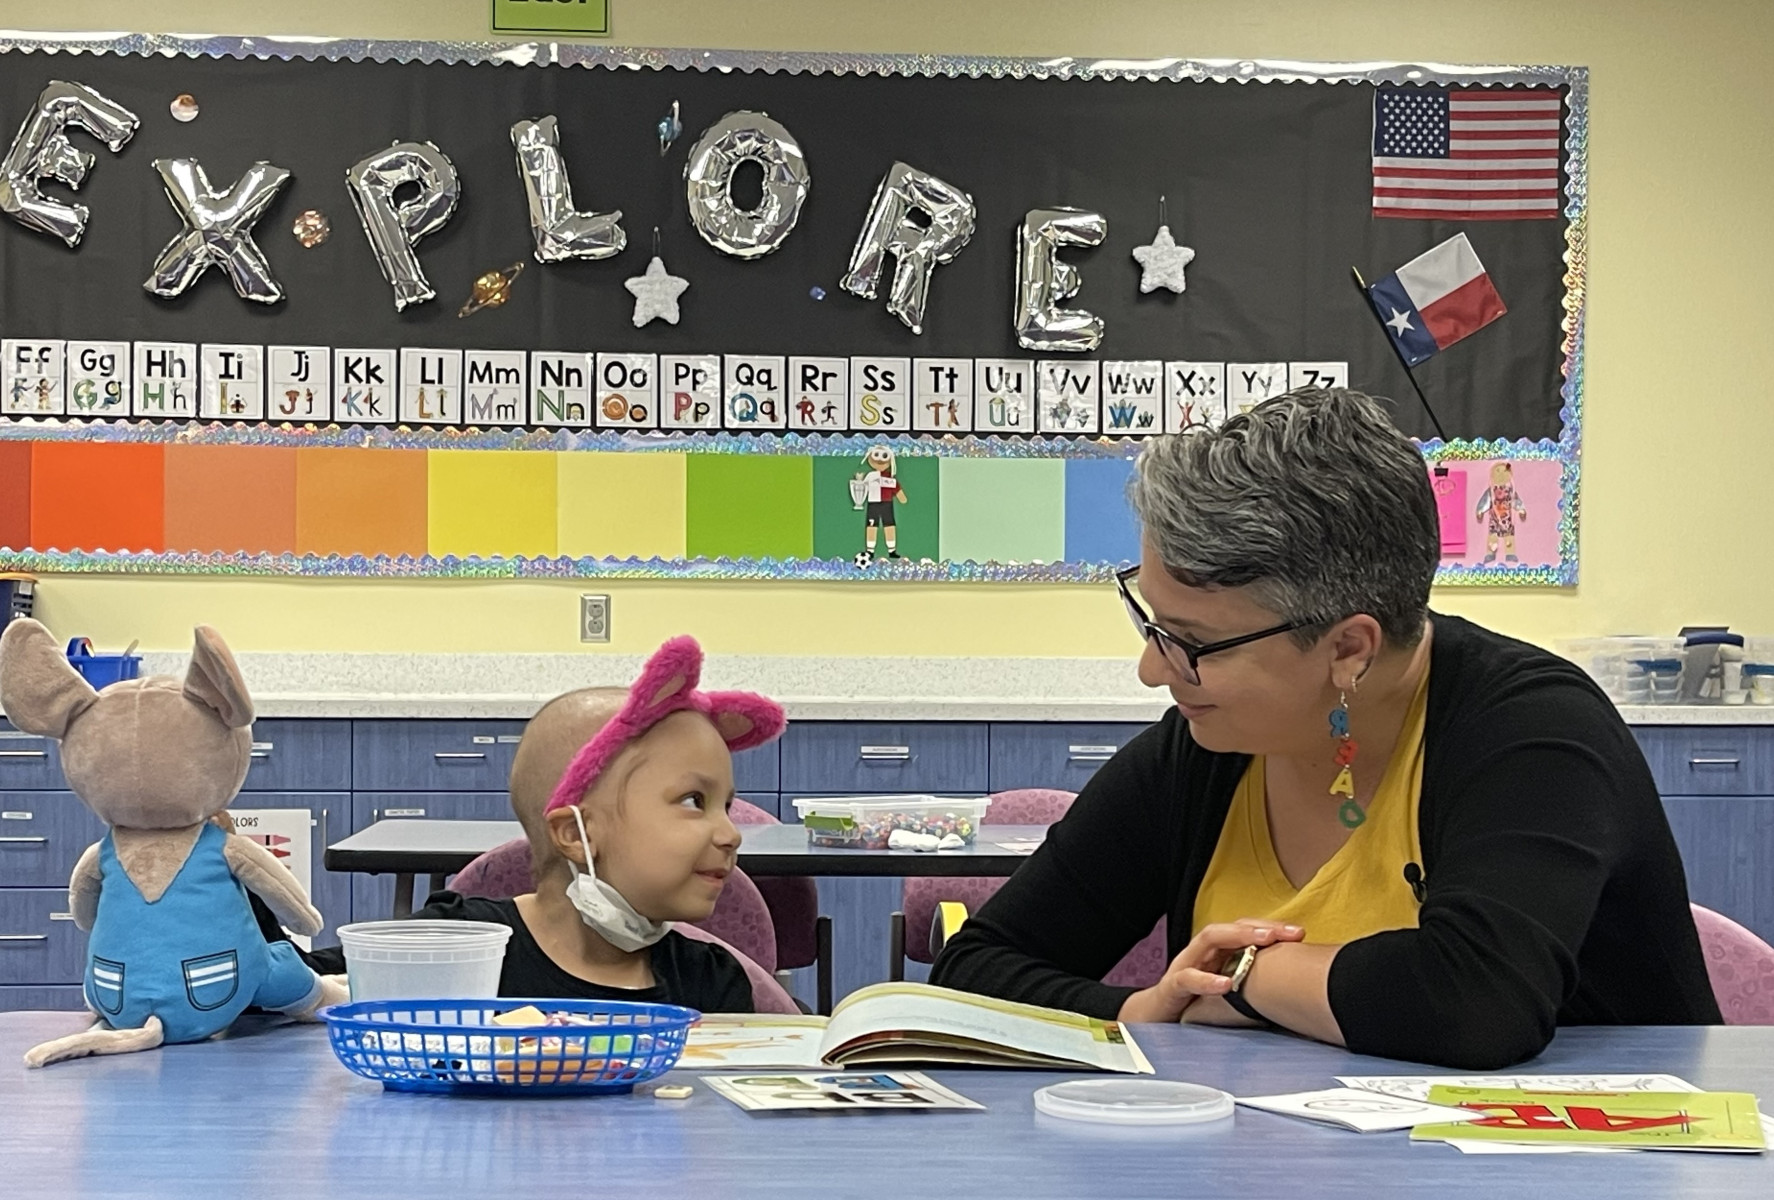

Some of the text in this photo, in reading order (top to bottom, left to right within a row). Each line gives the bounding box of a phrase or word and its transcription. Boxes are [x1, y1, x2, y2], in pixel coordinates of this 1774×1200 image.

[0, 80, 1107, 352] EXPLORE
[16, 346, 52, 374] Ff
[80, 349, 116, 377] Gg
[146, 350, 187, 378] Hh
[219, 352, 243, 380] Ii
[290, 351, 310, 382] Jj
[344, 356, 384, 384] Kk
[421, 357, 443, 384] Ll
[468, 360, 520, 384] Mm
[540, 360, 583, 387] Nn
[604, 361, 648, 388] Oo
[674, 363, 708, 391] Pp
[735, 363, 778, 391] Qq
[801, 364, 838, 392] Rr
[863, 365, 896, 392] Ss
[929, 366, 959, 393] Tt
[985, 366, 1022, 393] Uu
[1050, 368, 1091, 395] Vv
[1108, 372, 1155, 395] Ww
[1176, 370, 1215, 396] Xx
[1242, 371, 1273, 397] Yy
[537, 389, 585, 422] Nn
[602, 393, 648, 422] Oo
[674, 392, 710, 422] Pp
[731, 393, 778, 423] Qq
[860, 394, 896, 425] Ss
